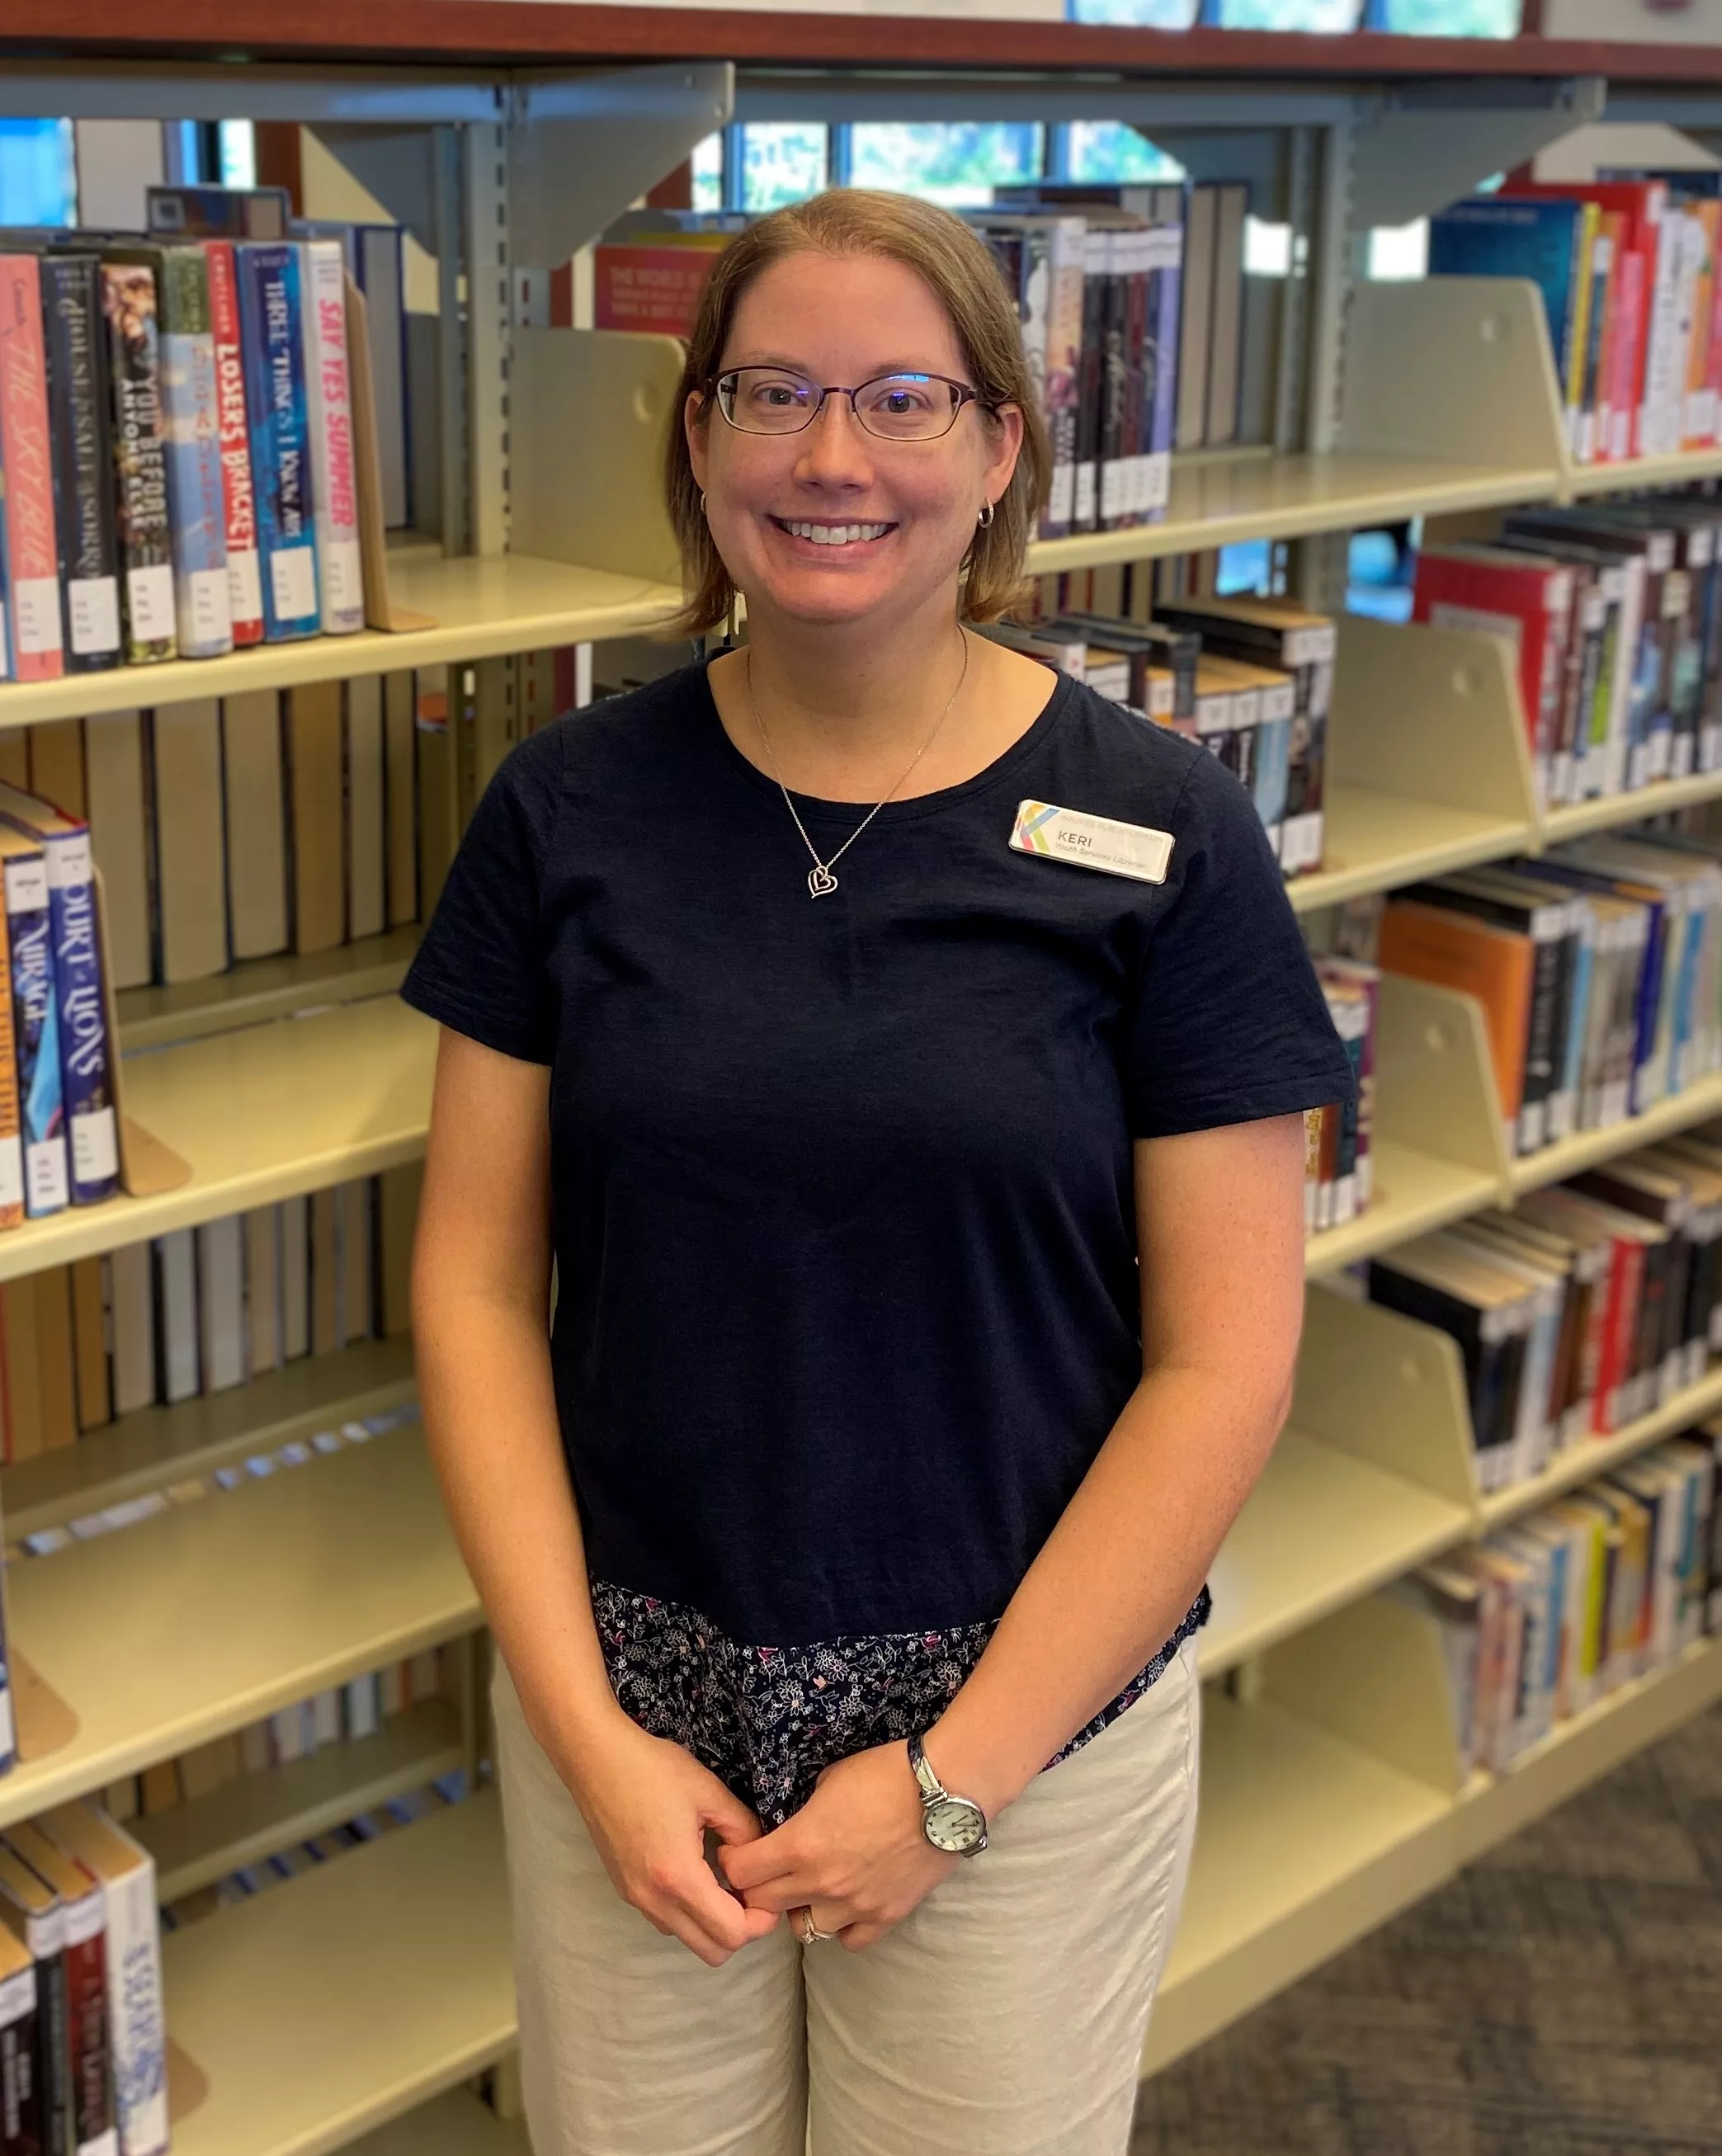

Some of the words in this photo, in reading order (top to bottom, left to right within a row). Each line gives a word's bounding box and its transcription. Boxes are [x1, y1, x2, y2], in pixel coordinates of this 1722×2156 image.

[265, 281, 289, 346] THREE
[318, 298, 346, 351] SAY
[7, 339, 40, 406] THE
[134, 375, 158, 424] YOU
[216, 343, 247, 443] LOSERS
[271, 347, 294, 431] THINGS
[323, 358, 348, 405] YES
[9, 413, 46, 494] SKY
[121, 378, 141, 472] ANYONE
[276, 435, 298, 445] I
[129, 477, 147, 529] ELSE
[138, 436, 167, 527] BEFORE
[219, 448, 256, 550] BRACKET
[278, 450, 300, 505] KNOW
[326, 411, 356, 528] SUMMER
[1055, 842, 1078, 853] Youth
[1079, 847, 1112, 861] Services
[1113, 856, 1148, 869] Librarian
[1058, 830, 1092, 847] KERI
[57, 885, 96, 968] OURT
[12, 917, 50, 1021] MIRAGE
[63, 984, 105, 1077] LIONS
